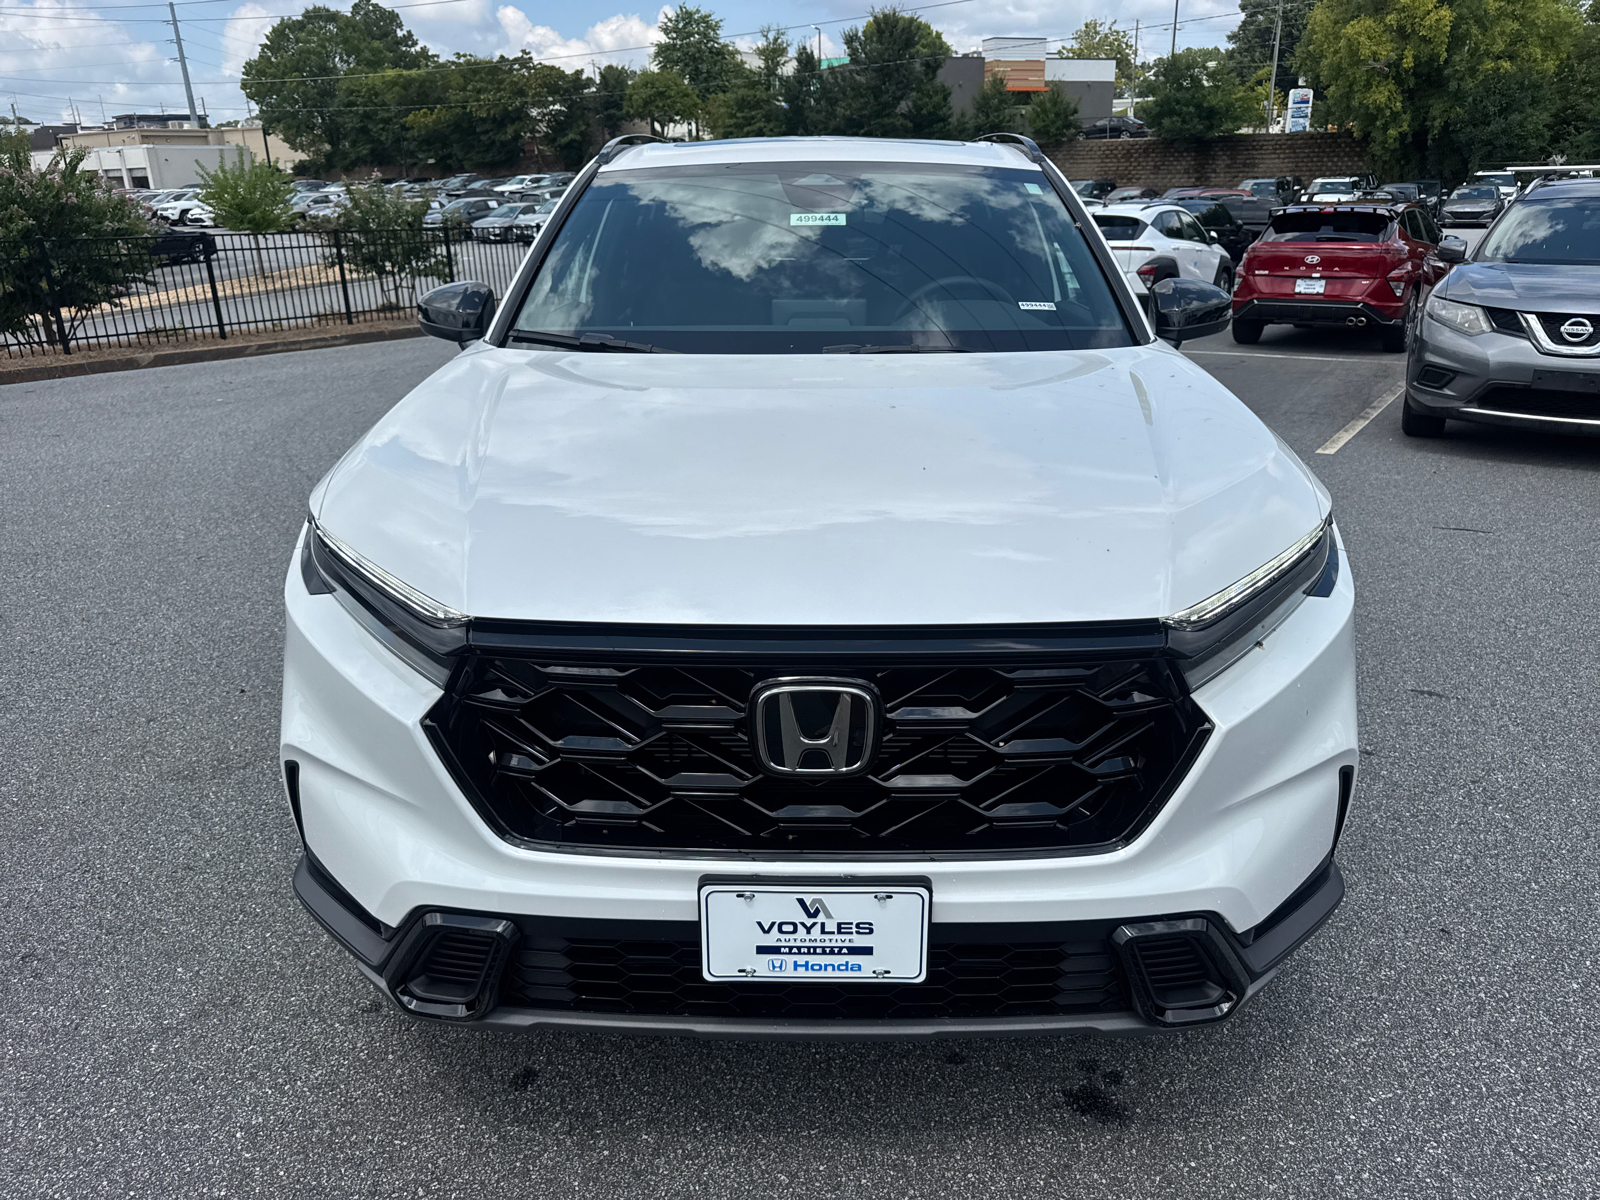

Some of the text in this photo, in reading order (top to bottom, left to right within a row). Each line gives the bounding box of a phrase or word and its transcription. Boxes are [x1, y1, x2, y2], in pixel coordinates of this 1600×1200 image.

[796, 215, 839, 223] 499444
[755, 921, 874, 935] VOYLES
[792, 960, 862, 972] Honda
